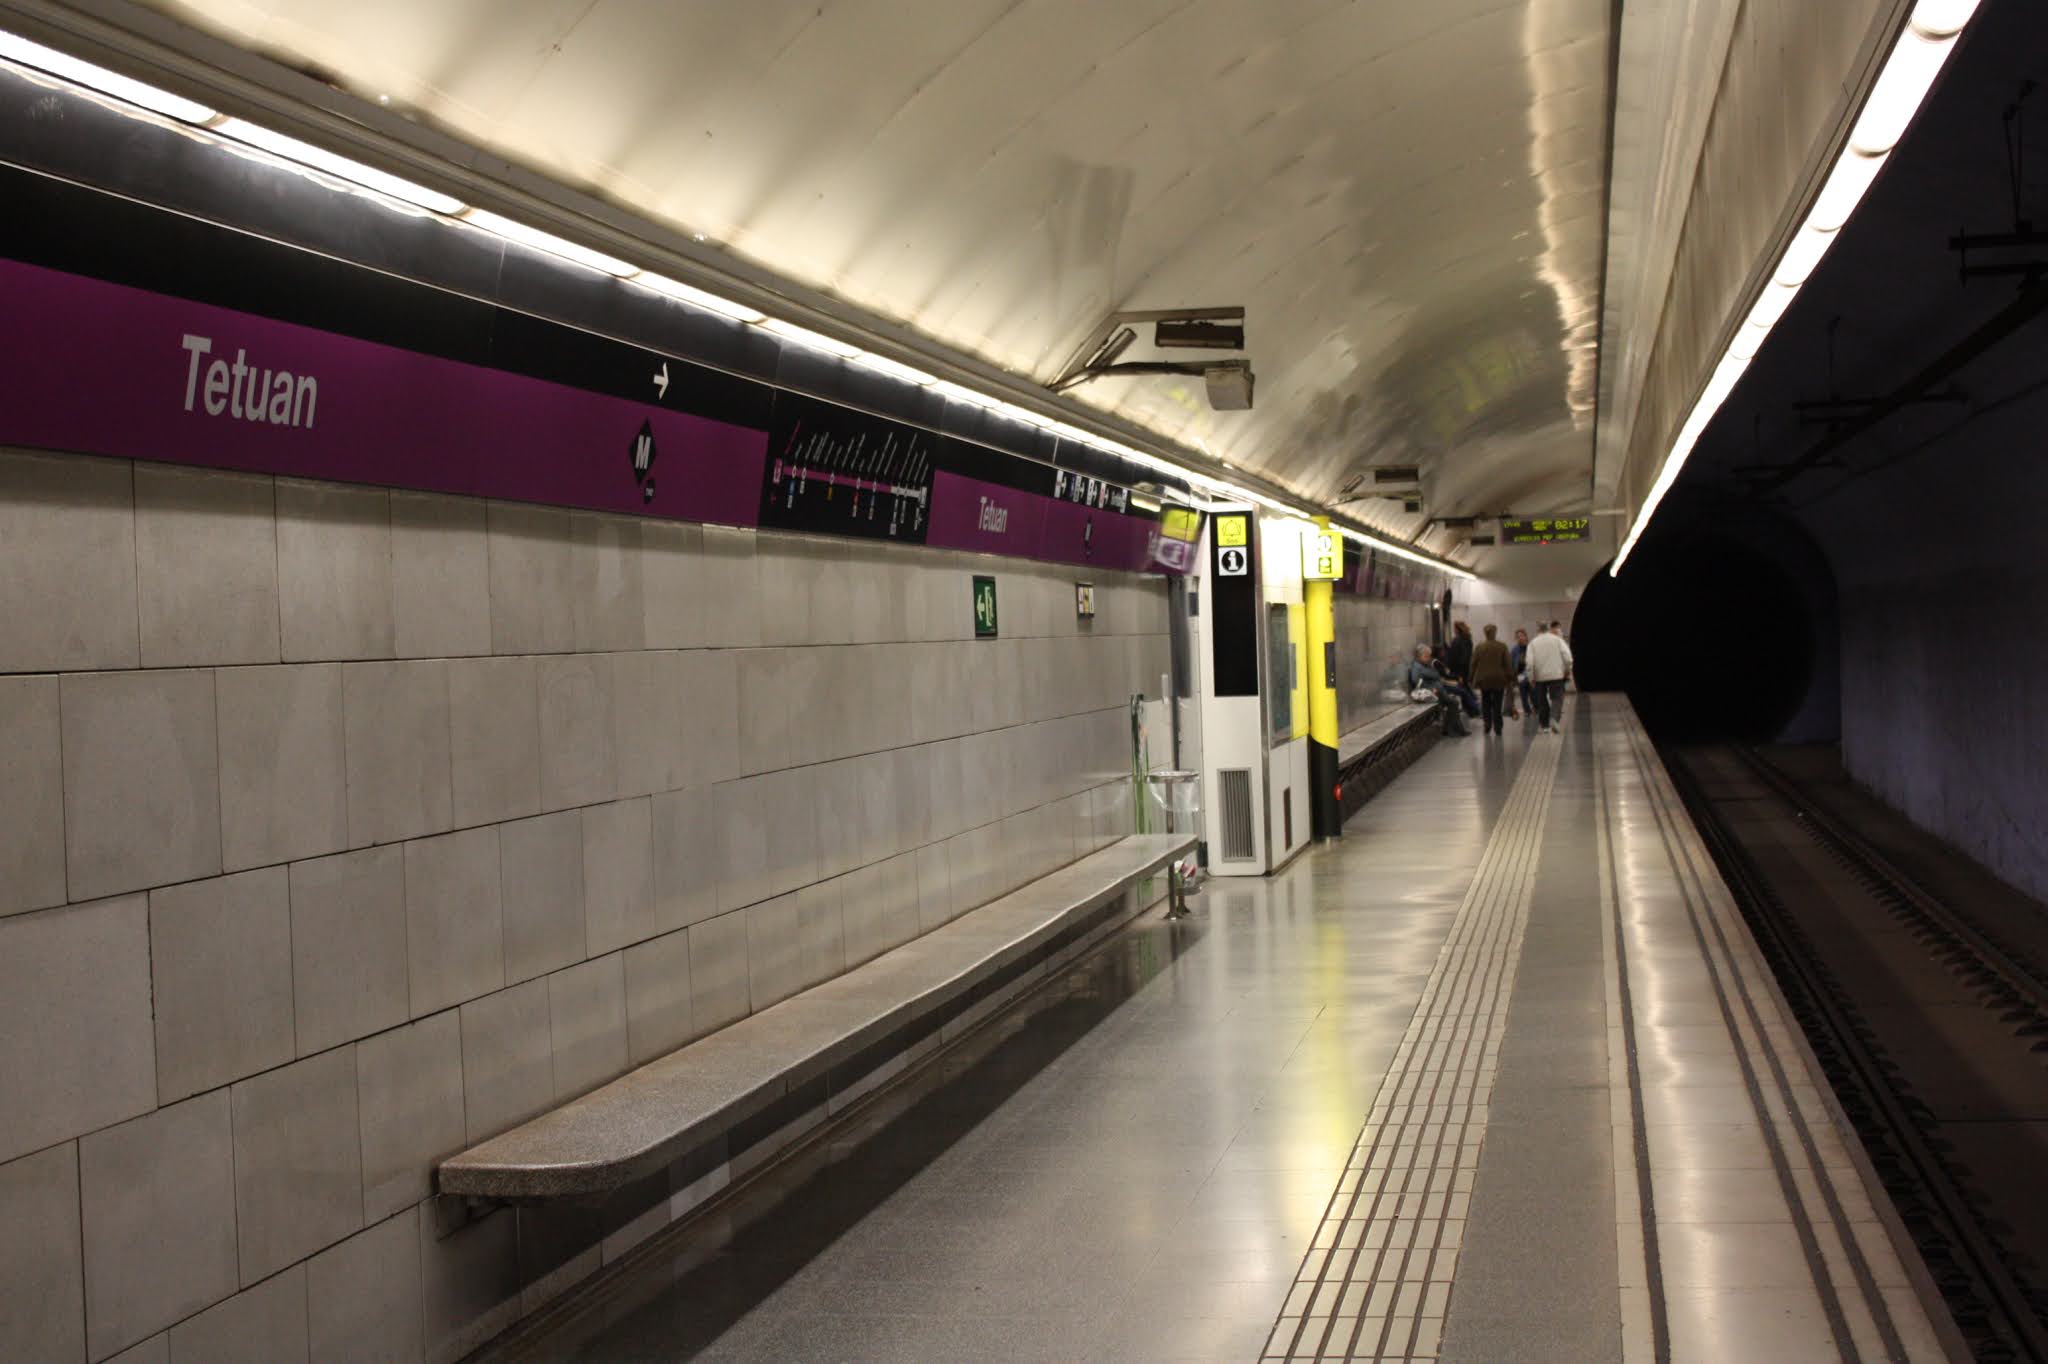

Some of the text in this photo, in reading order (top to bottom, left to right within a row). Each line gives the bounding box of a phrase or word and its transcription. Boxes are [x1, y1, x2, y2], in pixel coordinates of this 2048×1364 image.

[182, 334, 317, 428] Tetuan
[635, 434, 651, 469] M
[978, 495, 1008, 533] Tetuan
[1554, 518, 1588, 530] 02:17
